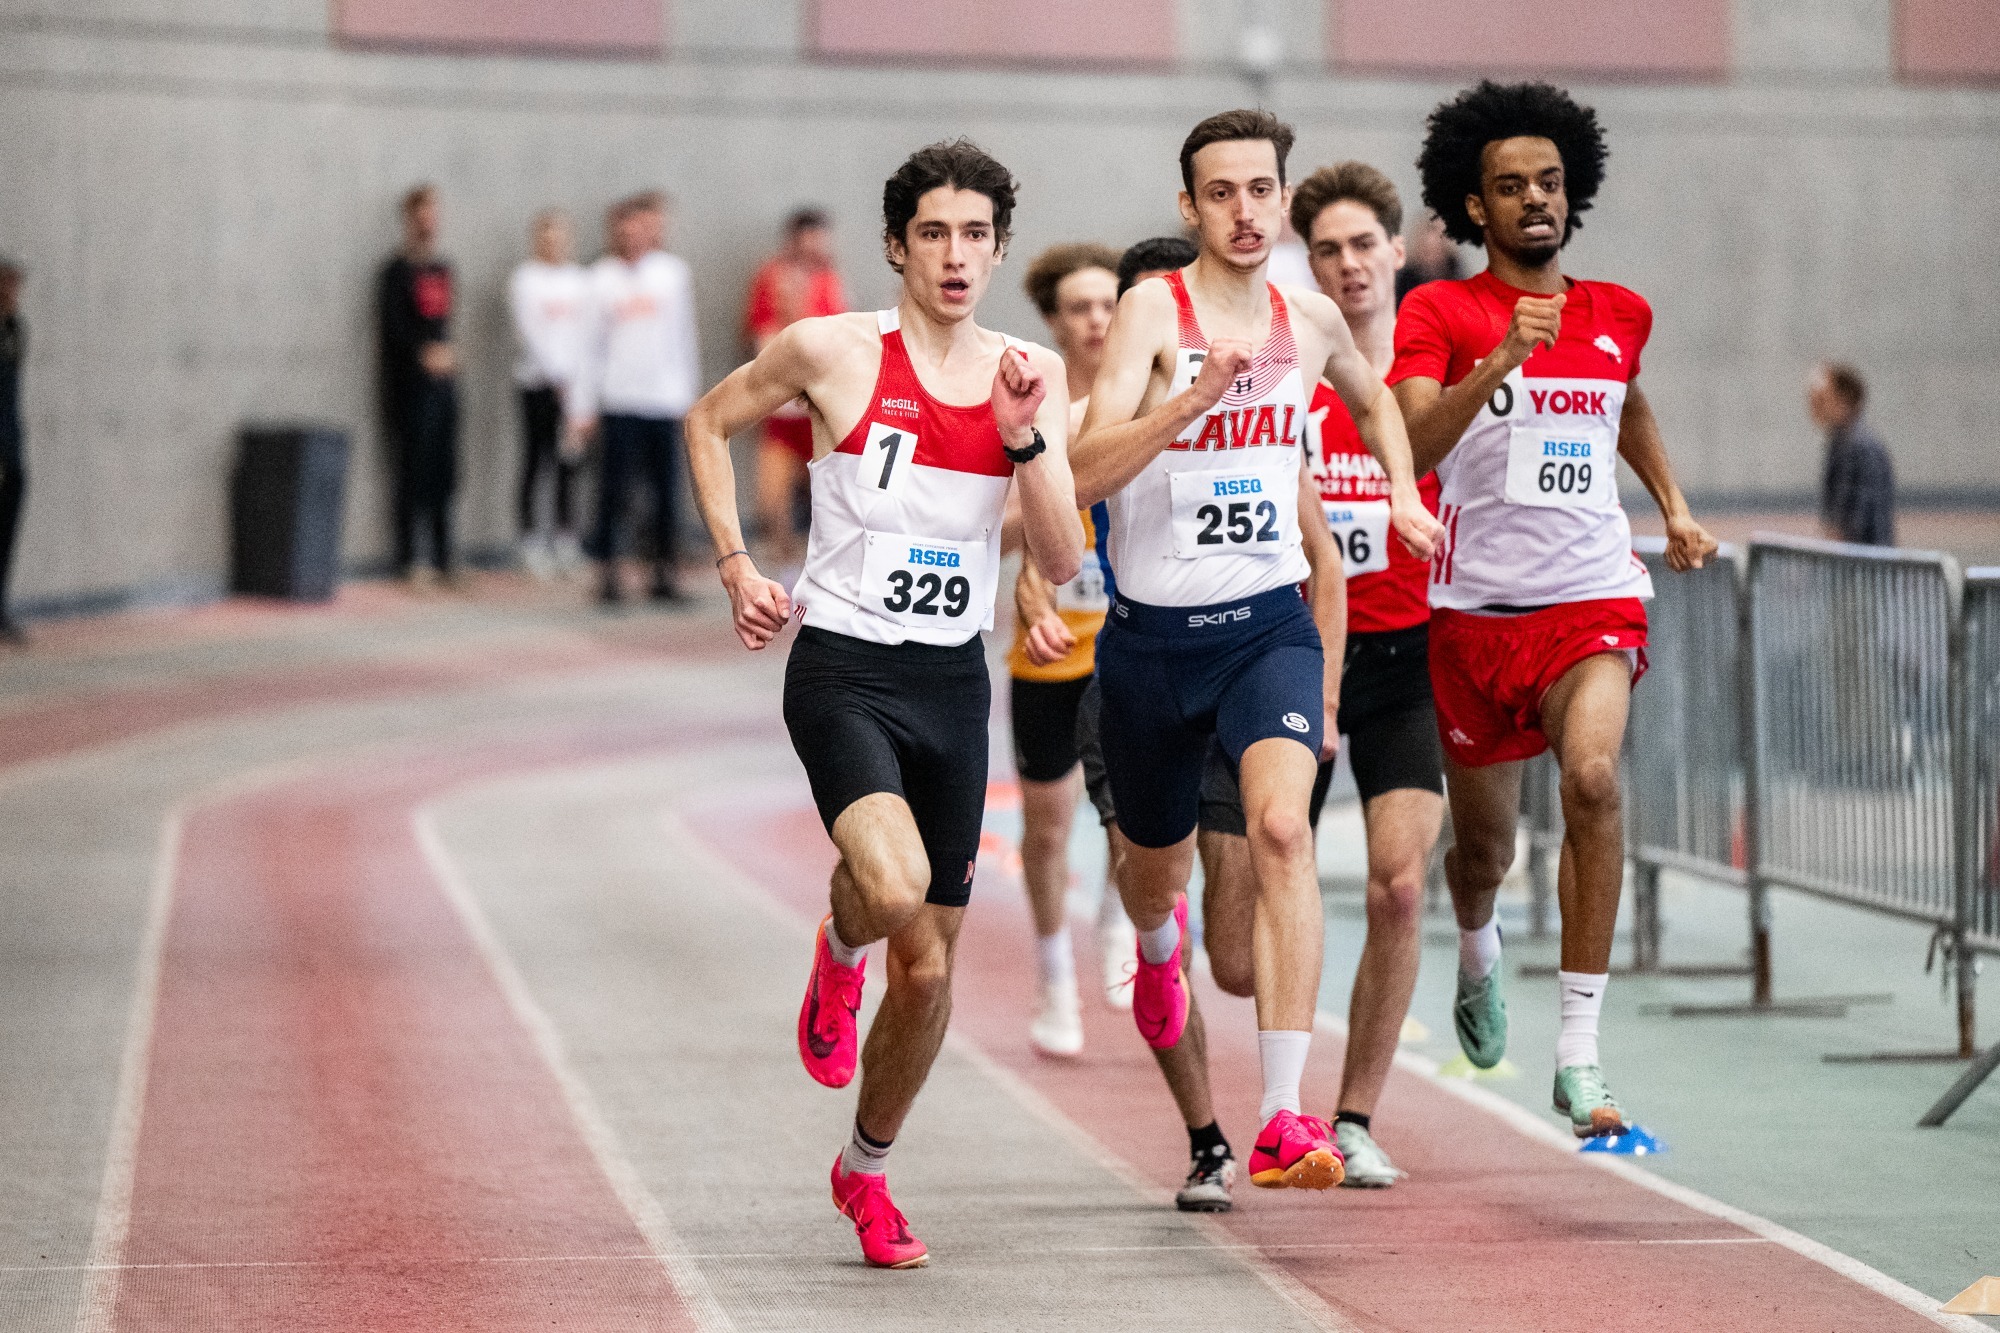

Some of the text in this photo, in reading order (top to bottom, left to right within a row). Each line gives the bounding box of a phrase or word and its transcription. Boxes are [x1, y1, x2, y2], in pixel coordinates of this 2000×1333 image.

[881, 408, 898, 416] TRACK
[904, 411, 919, 419] FIELD
[1529, 390, 1607, 416] YORK
[878, 432, 902, 490] 1
[1542, 441, 1592, 458] RSEQ
[1213, 478, 1263, 497] RSEQ
[1538, 462, 1593, 494] 609
[1196, 500, 1280, 546] 252
[908, 547, 961, 568] RSEQ
[883, 569, 971, 618] 329
